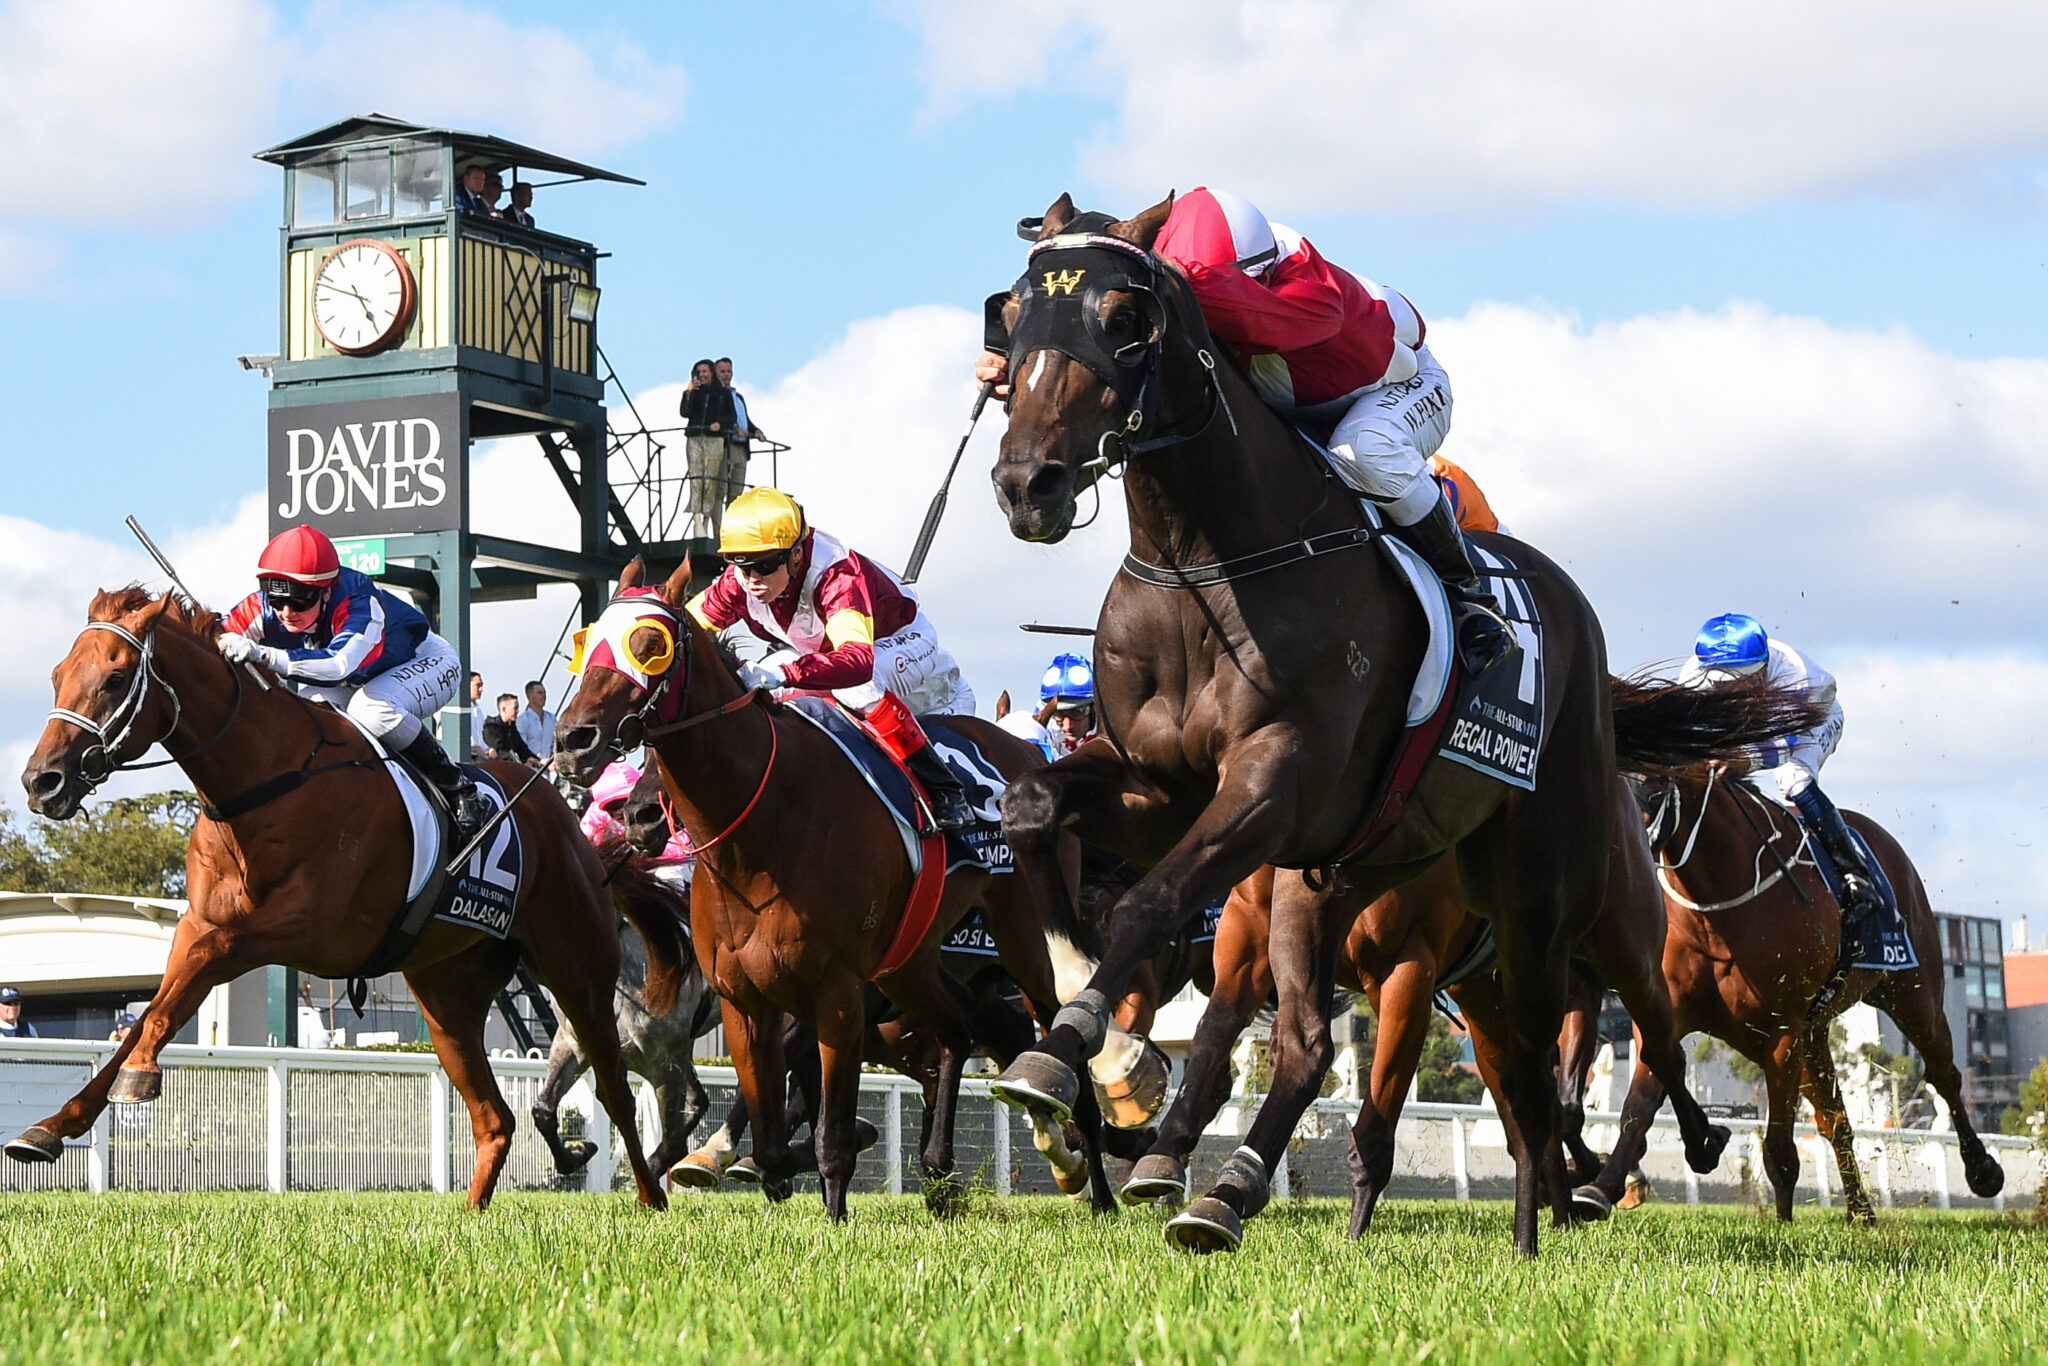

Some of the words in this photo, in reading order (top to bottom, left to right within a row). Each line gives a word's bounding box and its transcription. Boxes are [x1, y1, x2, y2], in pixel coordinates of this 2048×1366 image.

[286, 417, 441, 477] DAVID
[278, 456, 447, 519] JONES
[349, 552, 380, 573] 120
[1448, 718, 1492, 758] REGAL
[450, 895, 511, 930] DALASAN
